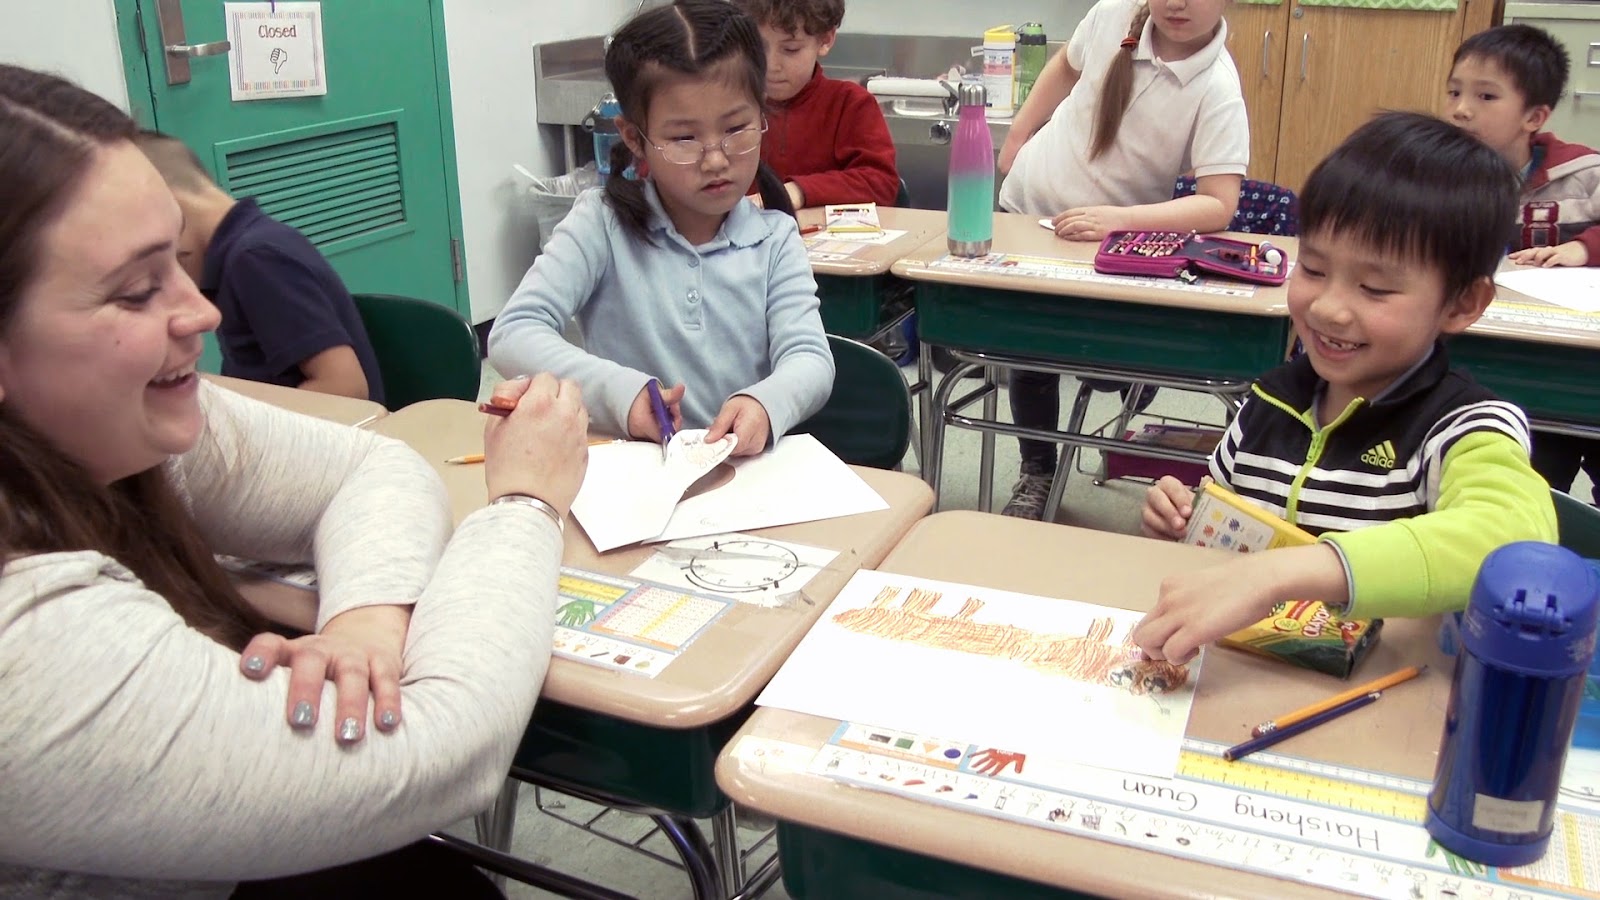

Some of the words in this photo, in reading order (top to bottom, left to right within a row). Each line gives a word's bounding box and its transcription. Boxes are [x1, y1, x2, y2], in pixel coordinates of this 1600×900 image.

[258, 24, 297, 39] Closed
[1361, 453, 1395, 469] adida
[1122, 778, 1198, 812] Guan
[1234, 794, 1381, 852] Haisheng
